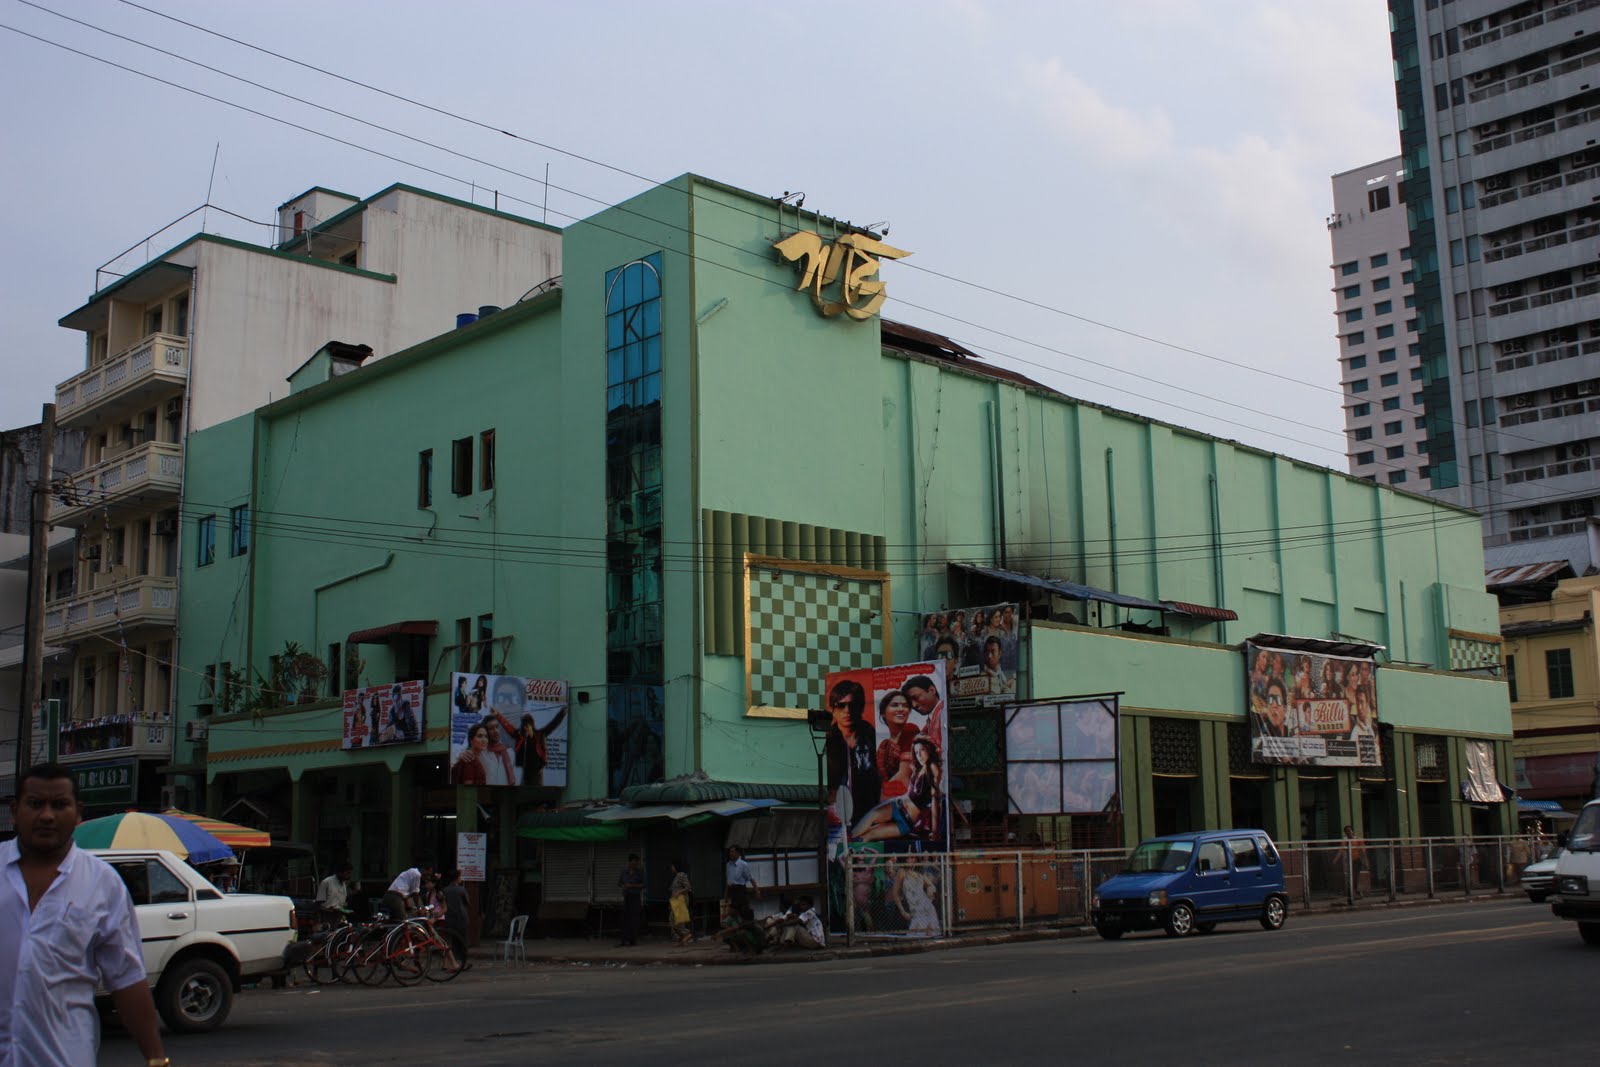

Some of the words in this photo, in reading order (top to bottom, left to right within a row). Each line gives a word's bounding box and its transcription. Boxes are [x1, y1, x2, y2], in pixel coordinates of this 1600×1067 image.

[524, 679, 562, 696] Billu
[624, 571, 642, 785] CINEA
[961, 677, 986, 690] Billu
[1313, 701, 1345, 723] Billu
